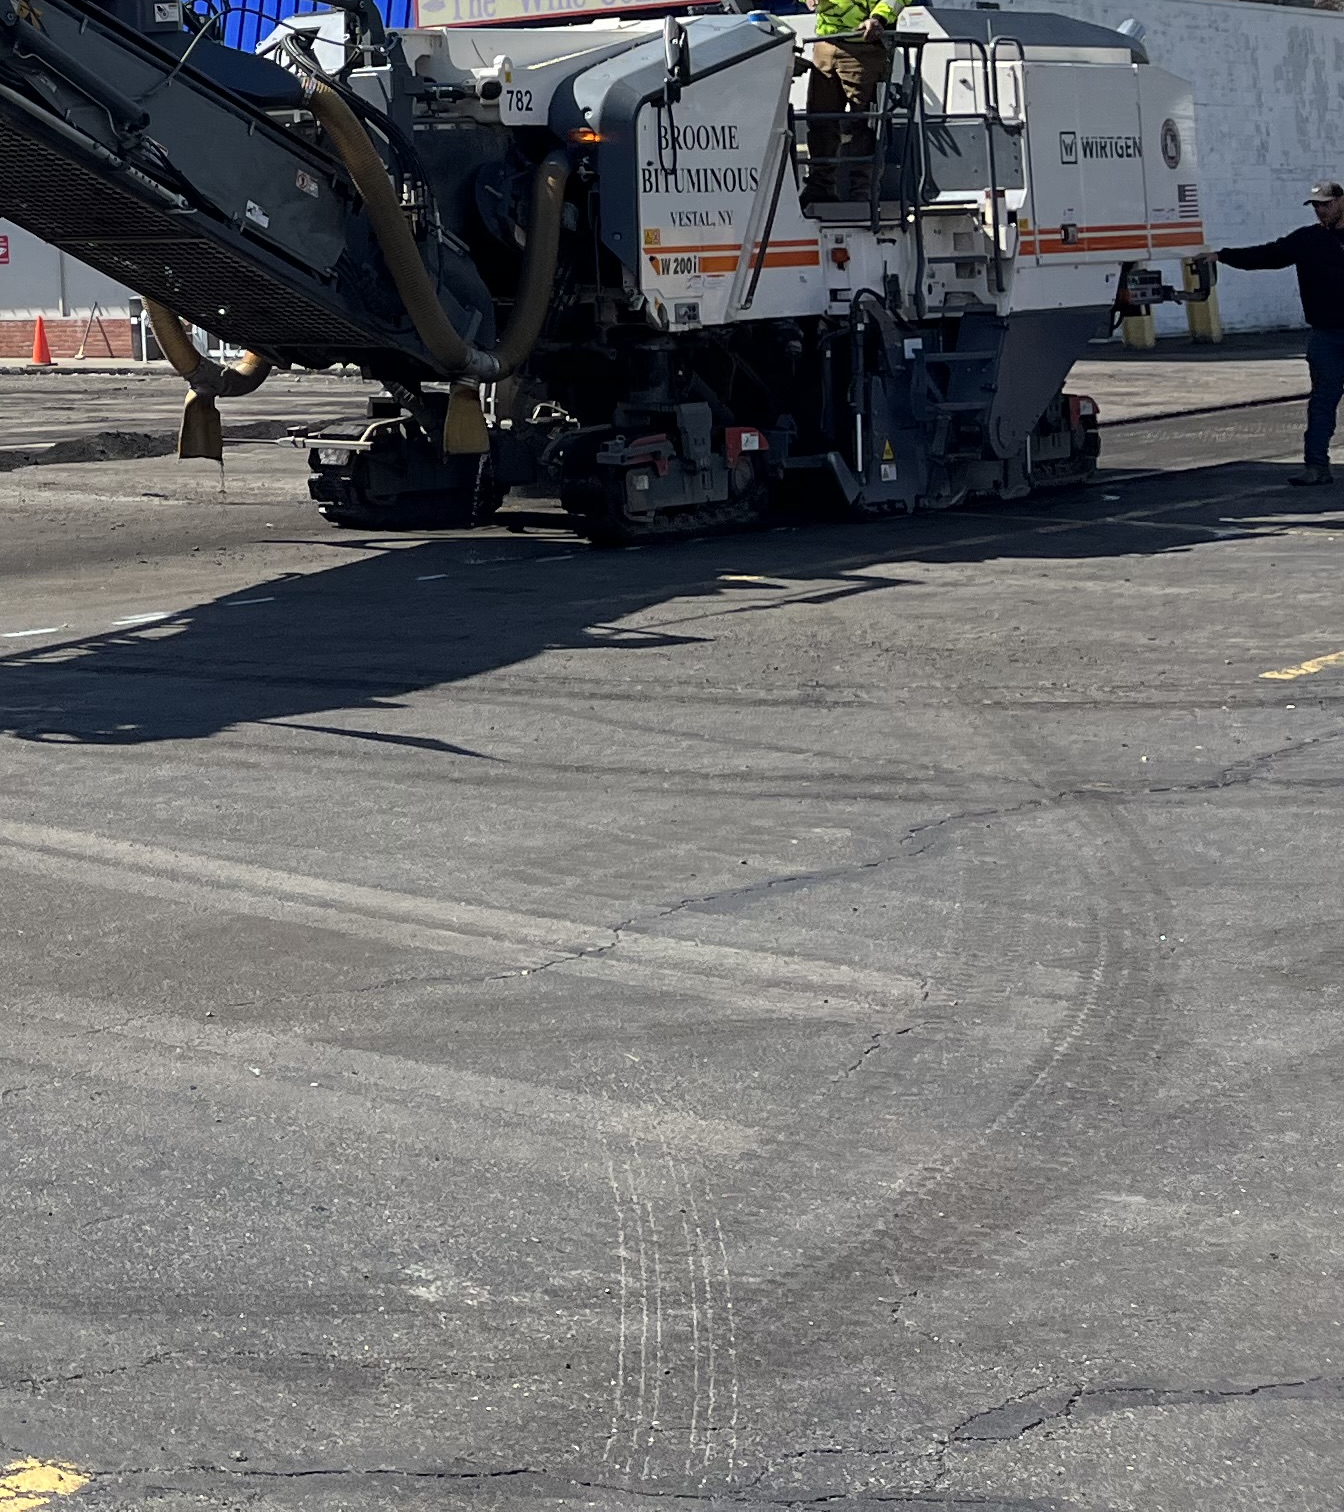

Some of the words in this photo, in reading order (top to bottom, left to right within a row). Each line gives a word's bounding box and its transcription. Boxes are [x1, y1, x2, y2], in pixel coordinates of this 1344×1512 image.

[506, 89, 534, 112] 782
[659, 124, 740, 151] BROOME
[1080, 136, 1144, 159] WIRTGEN
[641, 167, 760, 194] BITUMINOUS
[718, 210, 734, 226] NY
